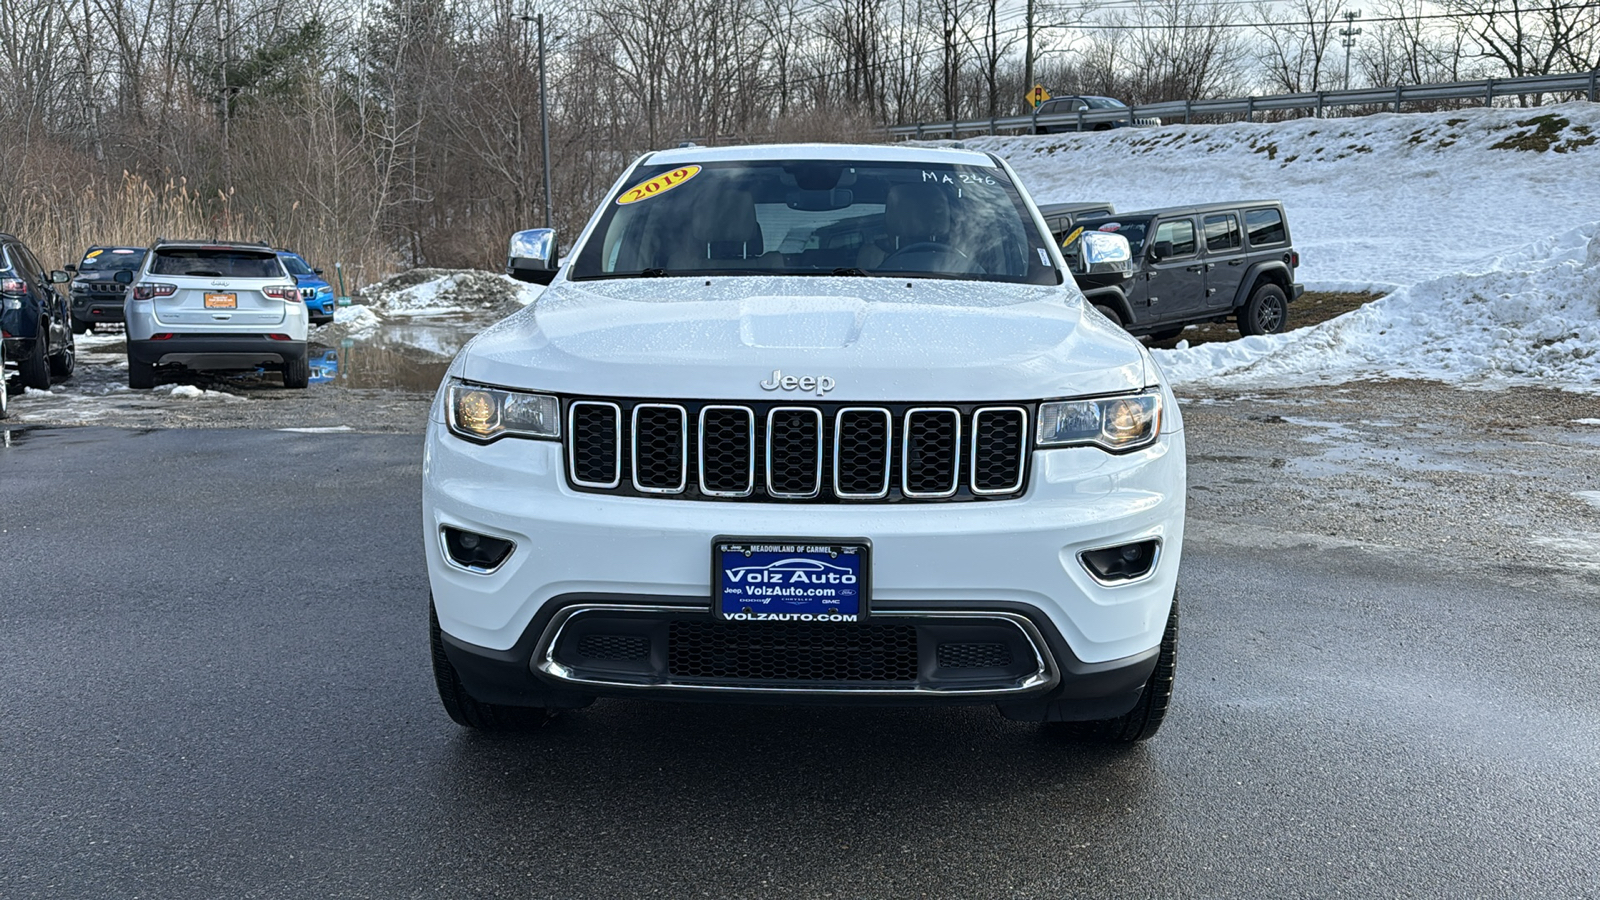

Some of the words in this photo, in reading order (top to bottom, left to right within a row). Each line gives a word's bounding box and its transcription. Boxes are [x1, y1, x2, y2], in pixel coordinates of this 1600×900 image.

[629, 169, 688, 201] 2019
[959, 174, 996, 185] 246
[760, 369, 835, 396] Jeep
[750, 545, 795, 553] MEADOWLAND
[796, 545, 806, 553] OF
[806, 546, 833, 554] CARMEL
[725, 569, 783, 583] Volz
[789, 570, 857, 584] Auto
[724, 587, 743, 595] Jeep
[745, 585, 836, 597] VolzAuto.com
[723, 612, 858, 622] VOLZAUTO.COM
